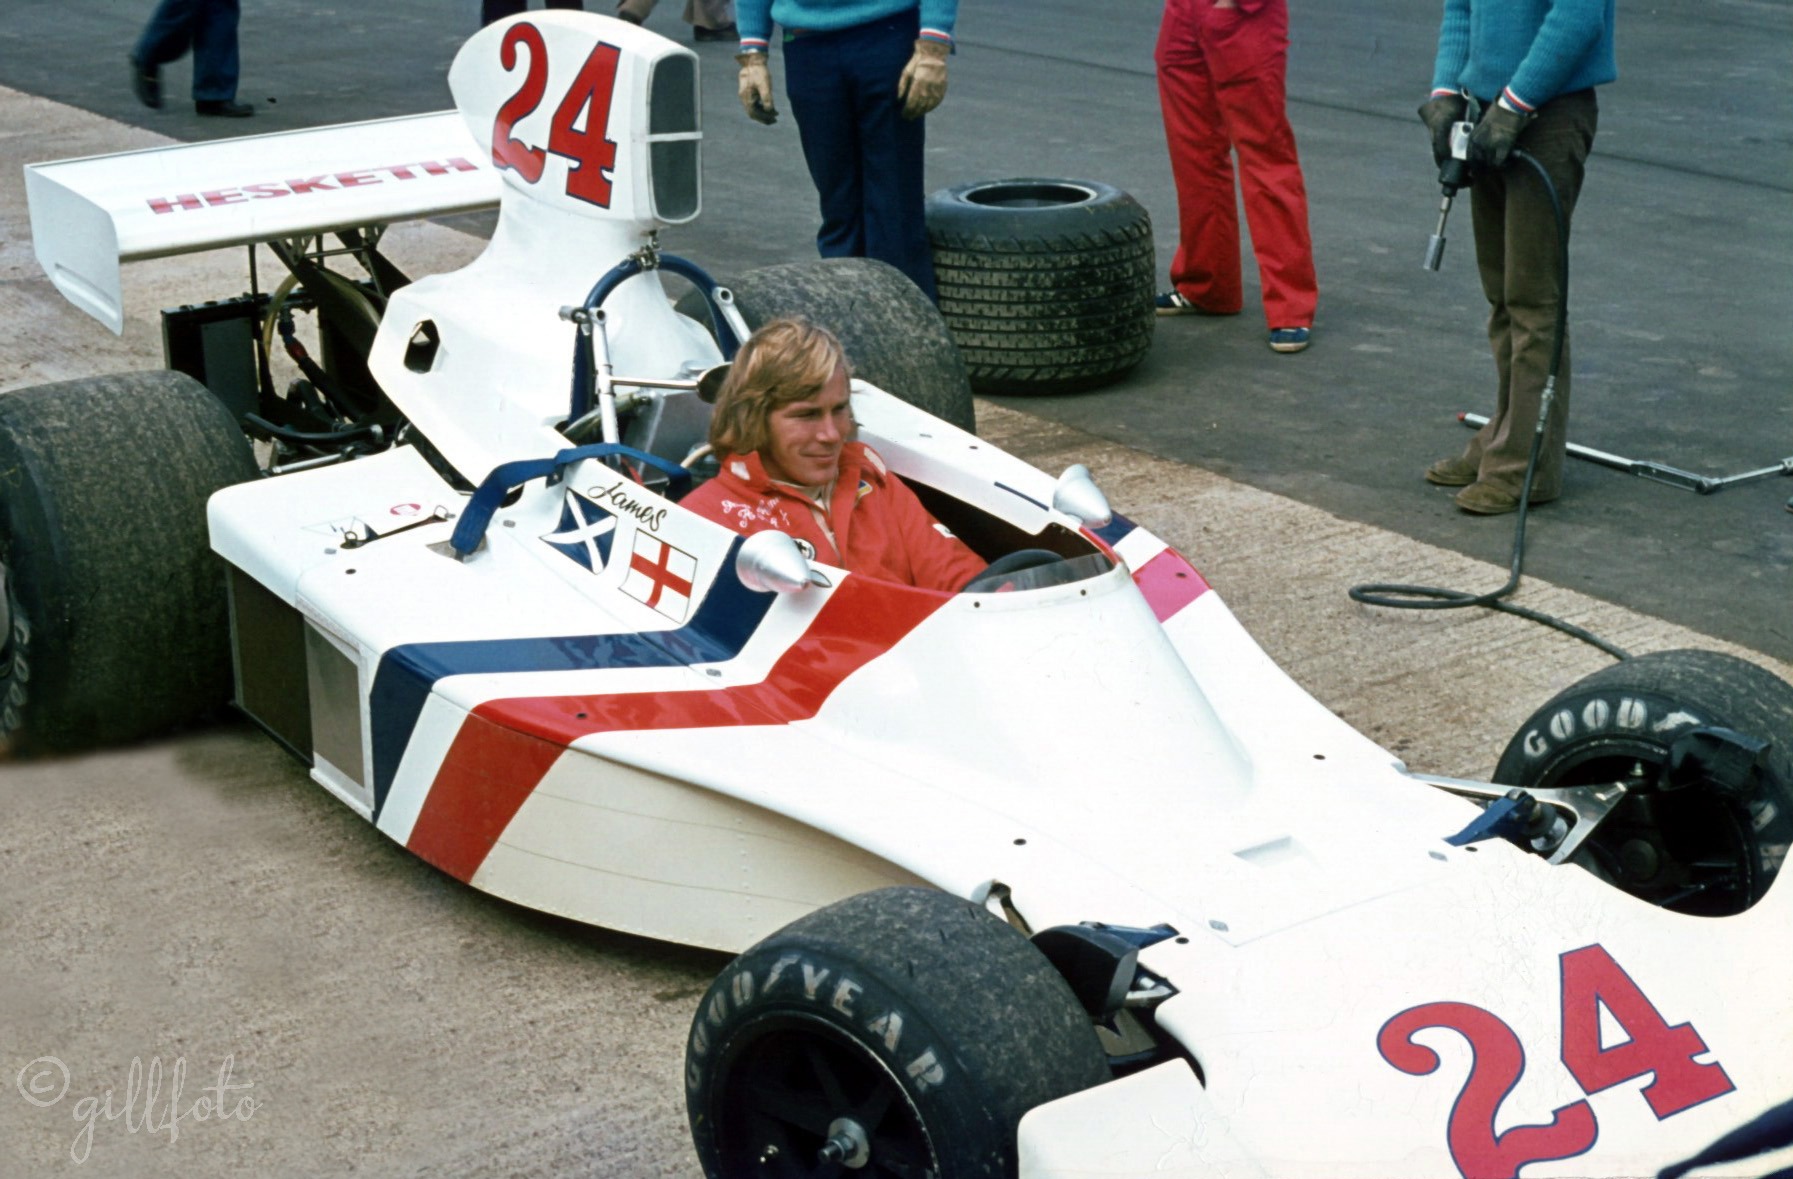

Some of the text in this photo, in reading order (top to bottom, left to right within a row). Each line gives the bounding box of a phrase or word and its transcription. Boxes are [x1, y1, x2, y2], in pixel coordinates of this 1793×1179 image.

[492, 21, 622, 210] 24
[146, 157, 479, 215] HESKETH
[587, 481, 667, 532] James
[687, 954, 945, 1093] GOODYEAR
[1376, 942, 1737, 1179] 24
